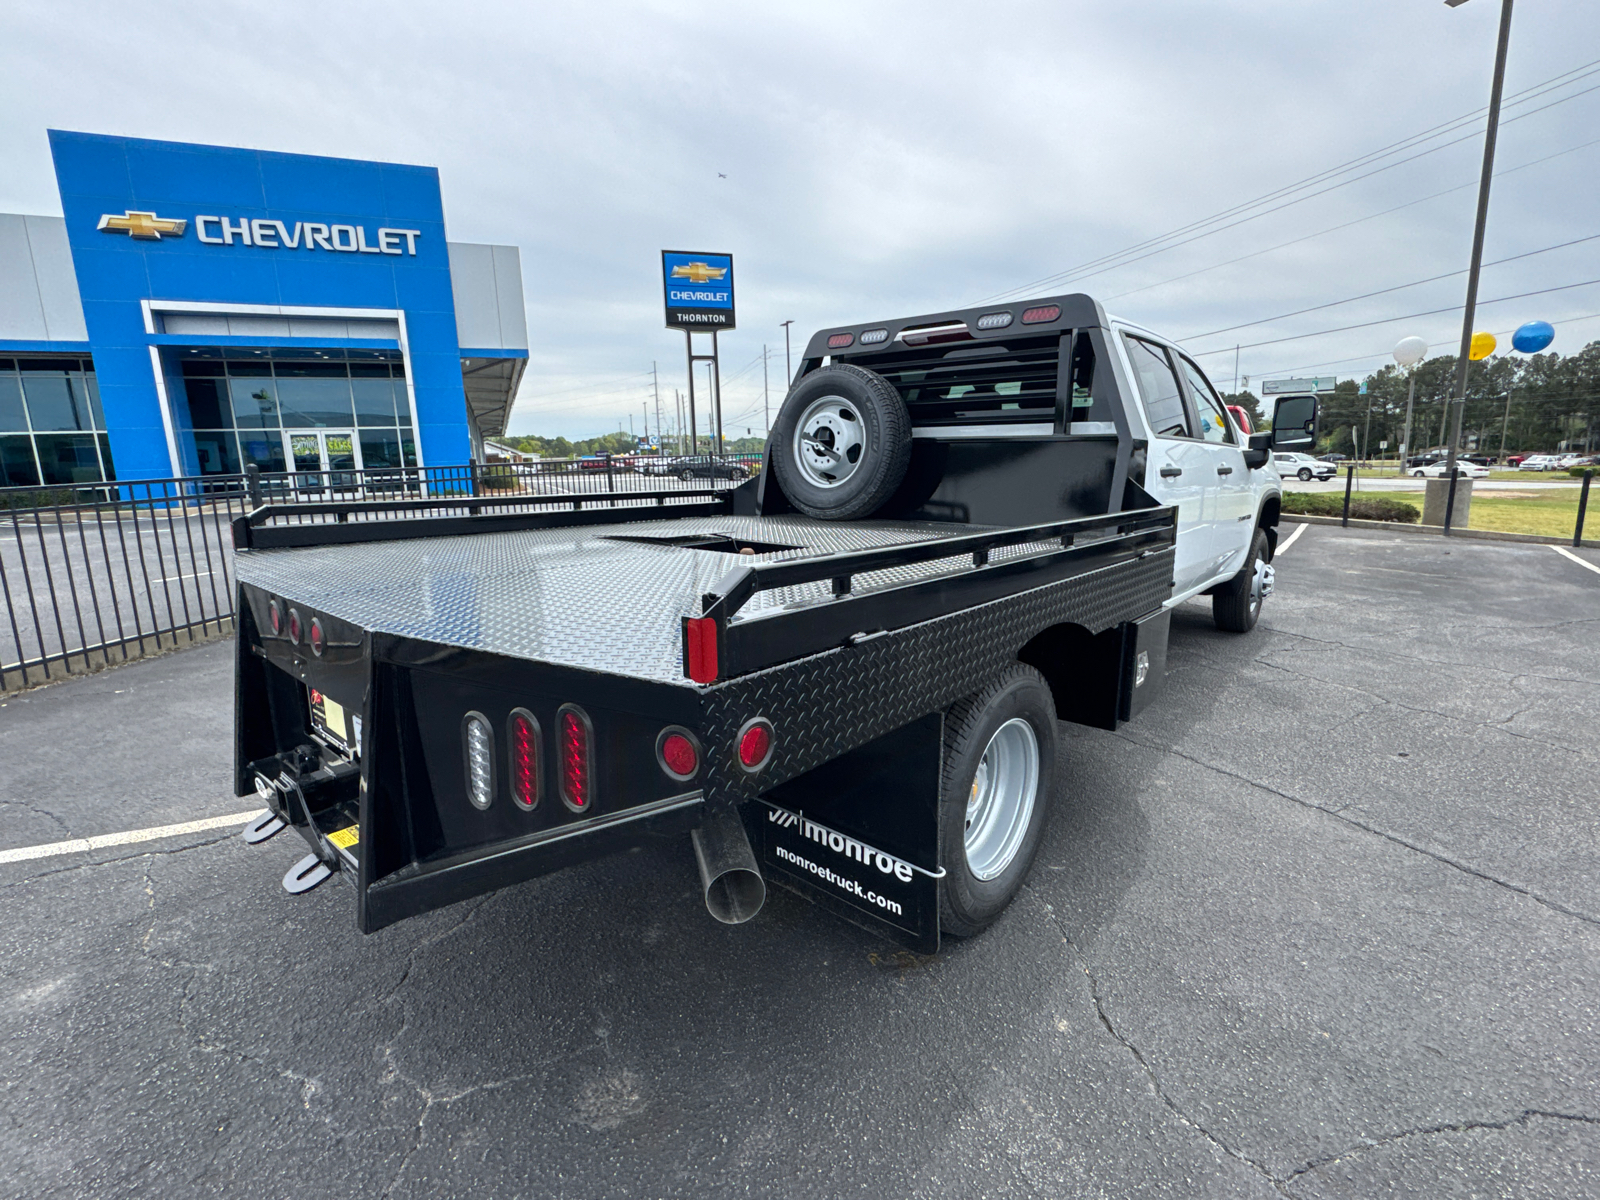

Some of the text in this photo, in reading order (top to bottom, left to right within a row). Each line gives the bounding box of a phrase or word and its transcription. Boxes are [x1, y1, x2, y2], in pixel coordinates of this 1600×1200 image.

[195, 214, 421, 256] CHEVROLET
[670, 290, 729, 302] CHEVROLET
[677, 313, 726, 323] THORNTON
[805, 820, 913, 883] monroe
[776, 845, 902, 916] monroetruck.com
